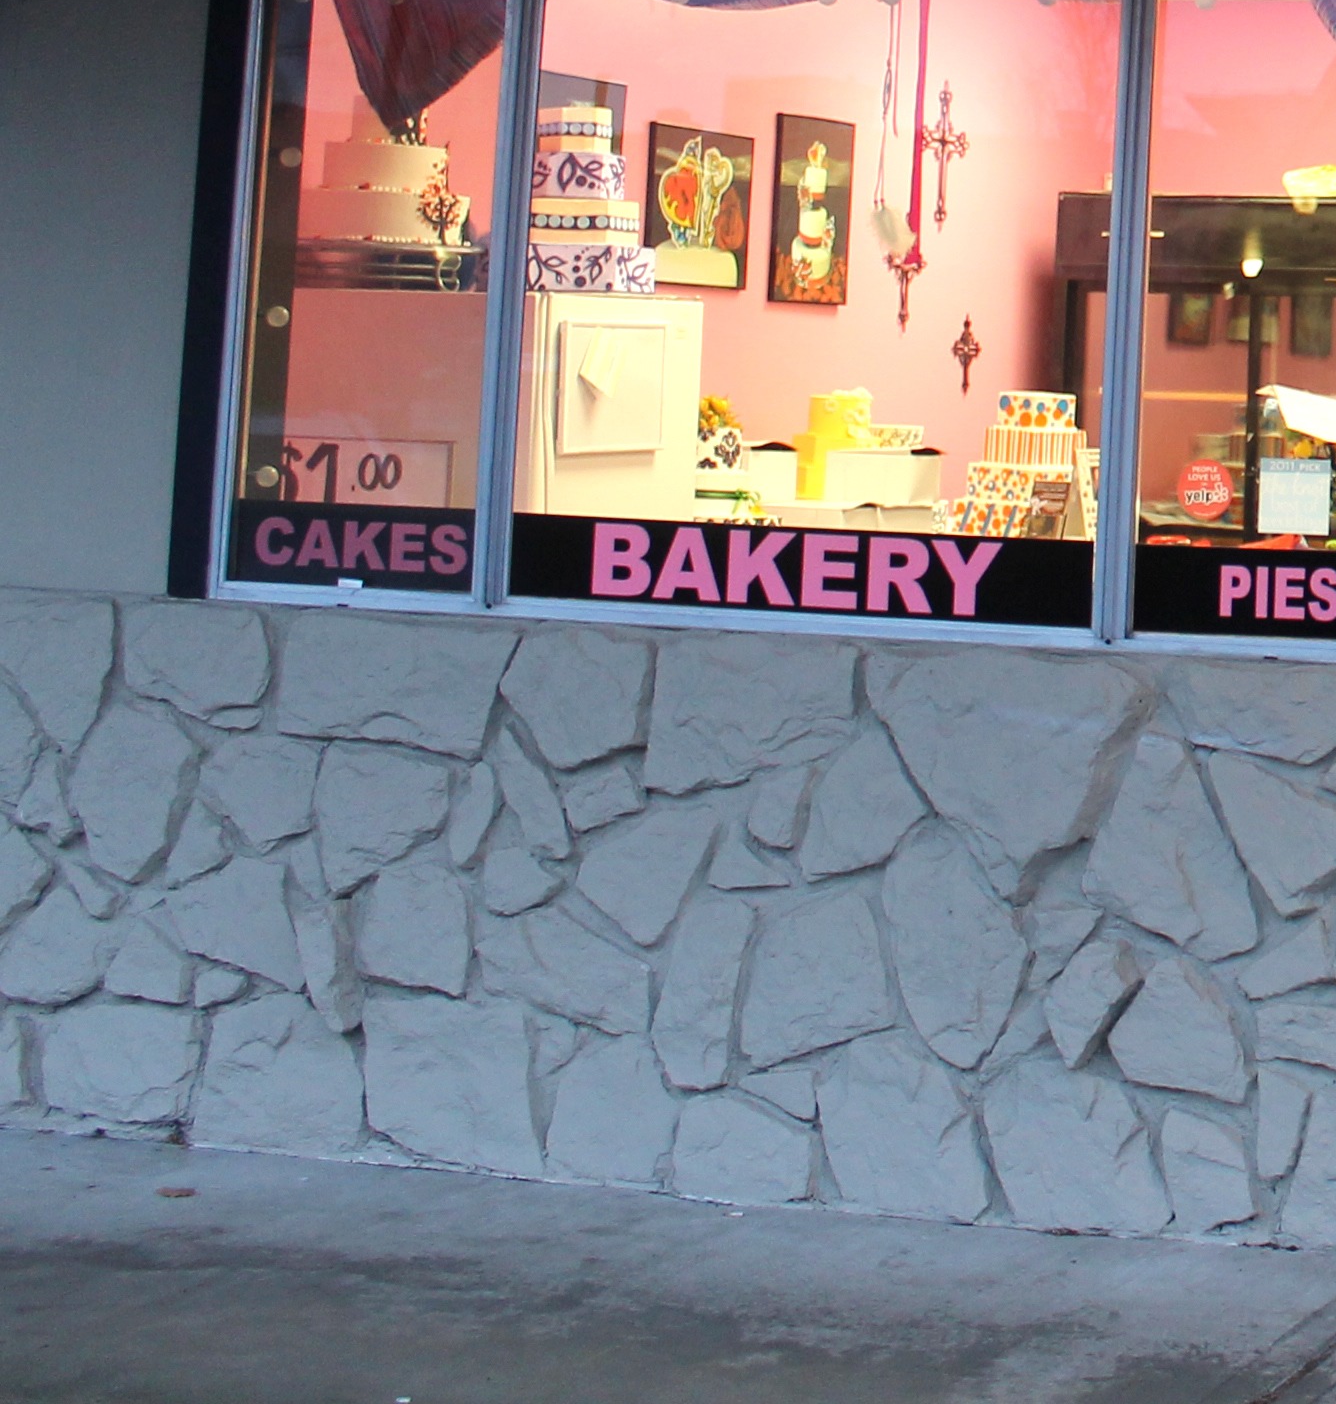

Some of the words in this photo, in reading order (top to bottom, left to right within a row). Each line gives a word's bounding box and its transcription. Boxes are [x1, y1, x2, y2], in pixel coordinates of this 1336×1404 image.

[1191, 465, 1218, 473] PEOPLE
[1270, 460, 1296, 472] 2011
[1299, 463, 1321, 472] PICK
[1187, 473, 1209, 481] LOVE
[1210, 474, 1222, 482] US
[1185, 488, 1214, 505] yelp
[255, 516, 468, 575] CAKES
[589, 523, 1001, 618] BAKERY
